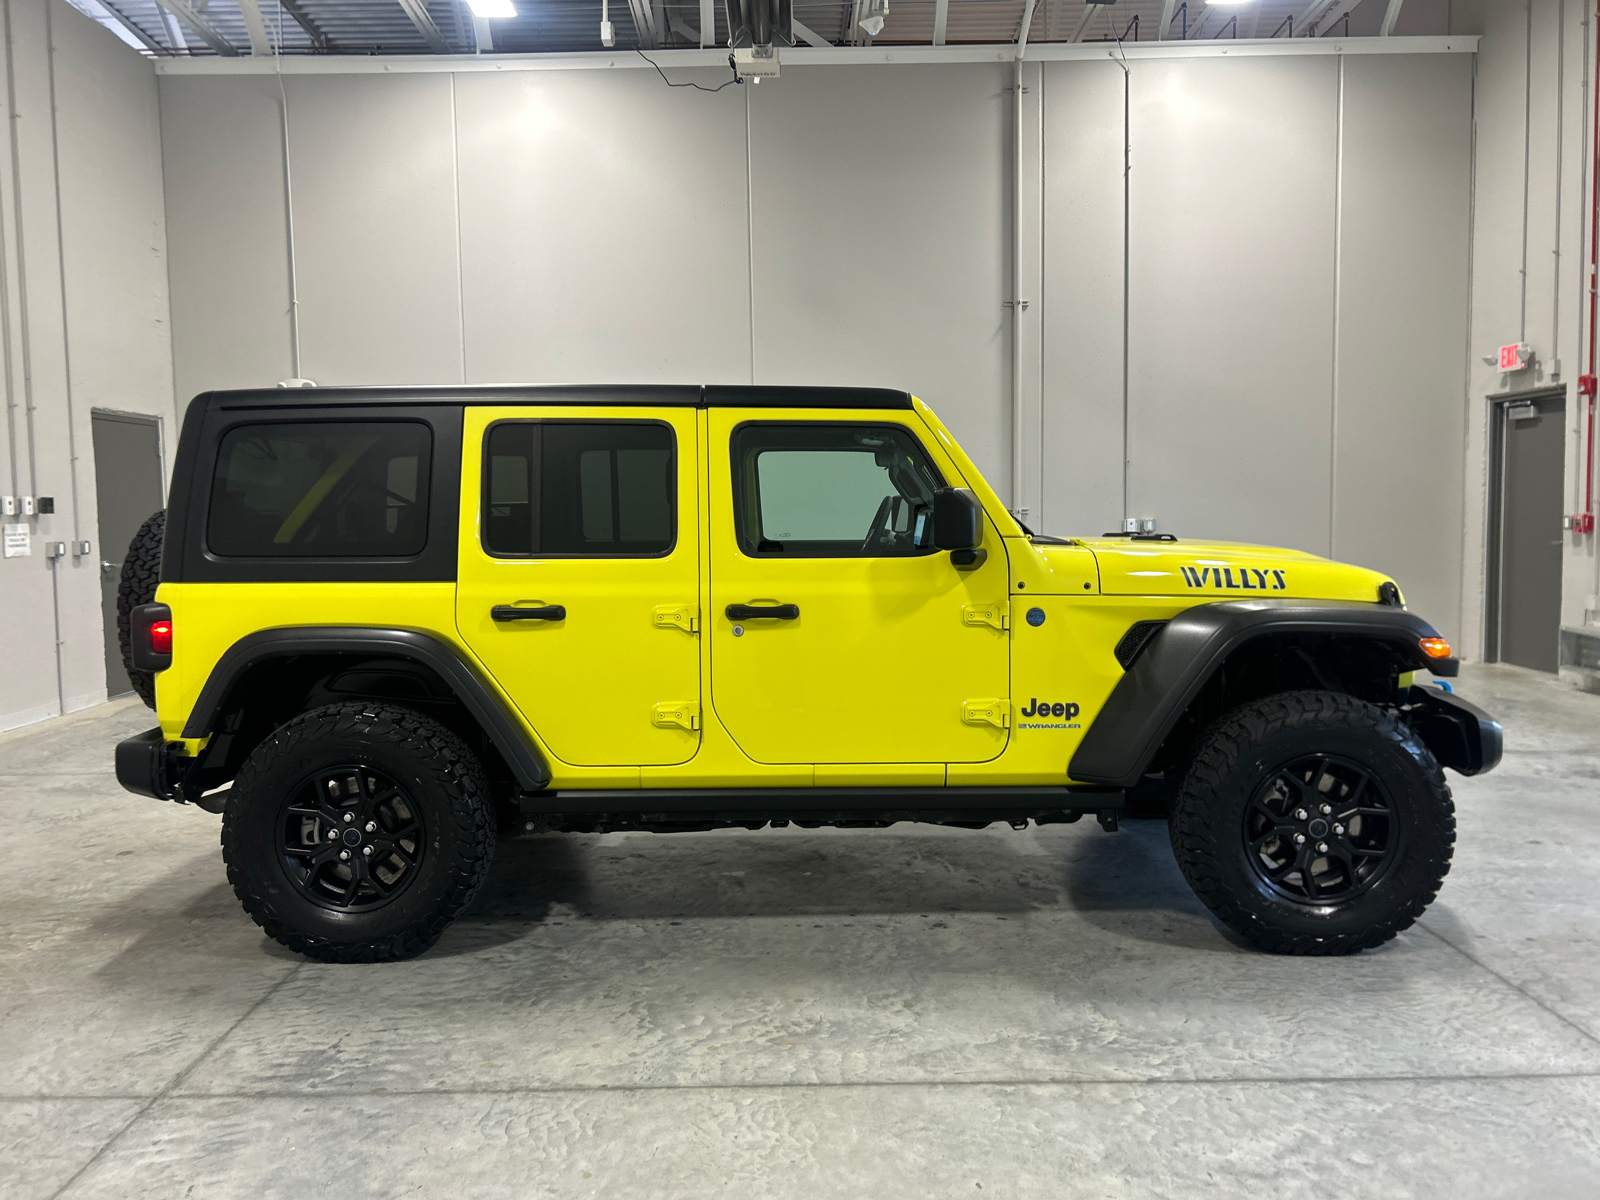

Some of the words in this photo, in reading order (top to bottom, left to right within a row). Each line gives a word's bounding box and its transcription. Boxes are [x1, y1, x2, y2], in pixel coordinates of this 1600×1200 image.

[1501, 344, 1519, 369] EXIT
[1180, 566, 1286, 590] WILLYS
[1021, 697, 1080, 721] Jeep
